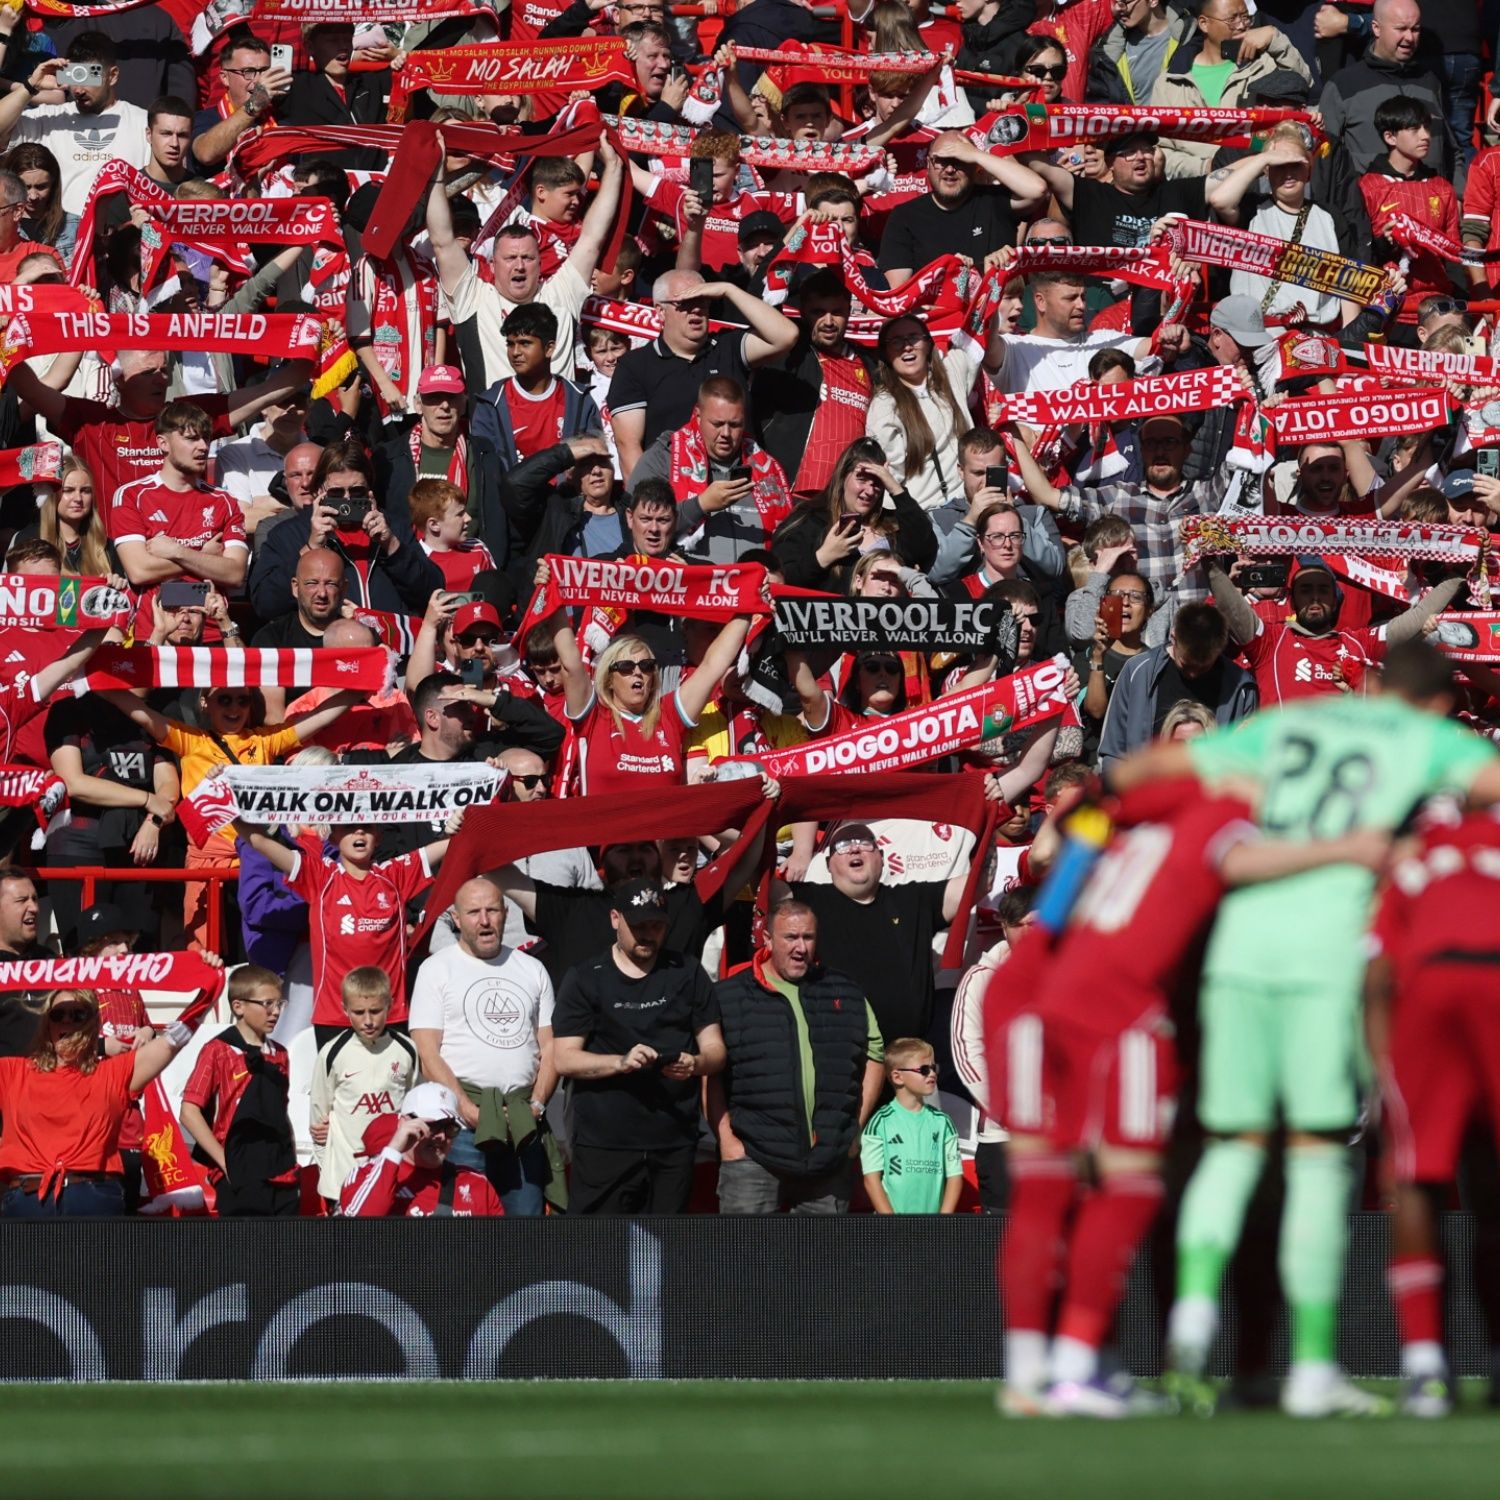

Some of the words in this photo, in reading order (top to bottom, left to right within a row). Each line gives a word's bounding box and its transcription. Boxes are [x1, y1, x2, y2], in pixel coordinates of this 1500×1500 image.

[466, 57, 501, 81] MO
[501, 54, 571, 81] SALAH
[483, 81, 497, 89] THE
[499, 81, 534, 90] EGYPTIAN
[537, 80, 554, 88] KING
[1062, 107, 1120, 115] 2020-2025
[1152, 109, 1182, 117] APPS
[1211, 110, 1247, 118] GOALS
[1049, 116, 1160, 138] DIOGO
[73, 151, 114, 162] adidas
[290, 203, 327, 222] FC
[183, 224, 225, 235] NEVER
[231, 224, 273, 235] WALK
[276, 223, 323, 235] ALONE
[1207, 221, 1258, 242] EUROPEAN
[1261, 234, 1289, 248] NIGHT
[1292, 244, 1303, 252] IN
[1305, 246, 1359, 268] LIVERPOOL
[1105, 259, 1152, 277] WALK
[1187, 228, 1276, 268] LIVERPOOL
[1280, 249, 1380, 297] BARCELONA
[1223, 259, 1266, 274] TUESDAY
[1281, 271, 1302, 284] MAY
[1304, 279, 1327, 291] 2019
[54, 312, 111, 338] THIS
[128, 313, 150, 337] IS
[168, 313, 267, 340] ANFIELD
[288, 327, 298, 349] THIS
[1368, 344, 1483, 376] LIVERPOOL
[1393, 368, 1418, 377] YOU'LL
[1421, 371, 1446, 380] NEVER
[1041, 379, 1126, 404] YOU'LL
[1133, 373, 1208, 394] NEVER
[1050, 400, 1118, 420] WALK
[1124, 389, 1201, 417] ALONE
[1350, 398, 1441, 426] DIOGO
[1275, 408, 1341, 434] JOTA
[1330, 426, 1368, 438] LIVERPOOL
[551, 557, 688, 593] LIVERPOOL
[709, 568, 741, 595] FC
[601, 589, 640, 604] NEVER
[651, 593, 686, 606] WALK
[696, 594, 740, 608] ALONE
[0, 616, 44, 627] RASIL
[774, 602, 947, 633] LIVERPOOL
[954, 602, 993, 634] FC
[784, 631, 825, 644] YOU'LL
[830, 630, 879, 643] NEVER
[885, 630, 929, 644] WALK
[934, 631, 985, 645] ALONE
[805, 729, 900, 775] DIOGO
[902, 705, 980, 748] JOTA
[617, 761, 662, 774] Chartered
[620, 753, 660, 765] Standard
[868, 757, 899, 774] NEVER
[901, 748, 929, 764] WALK
[931, 738, 961, 757] ALONE
[1264, 733, 1375, 840] 28
[234, 791, 310, 812] WALK
[315, 792, 361, 814] ON,
[370, 789, 450, 812] WALK
[268, 813, 301, 822] WITH
[309, 813, 343, 822] HOPE
[351, 813, 365, 821] IN
[374, 812, 408, 821] YOUR
[416, 811, 450, 820] HEAR
[0, 952, 174, 984] CHAMPION
[351, 1090, 395, 1115] AXA
